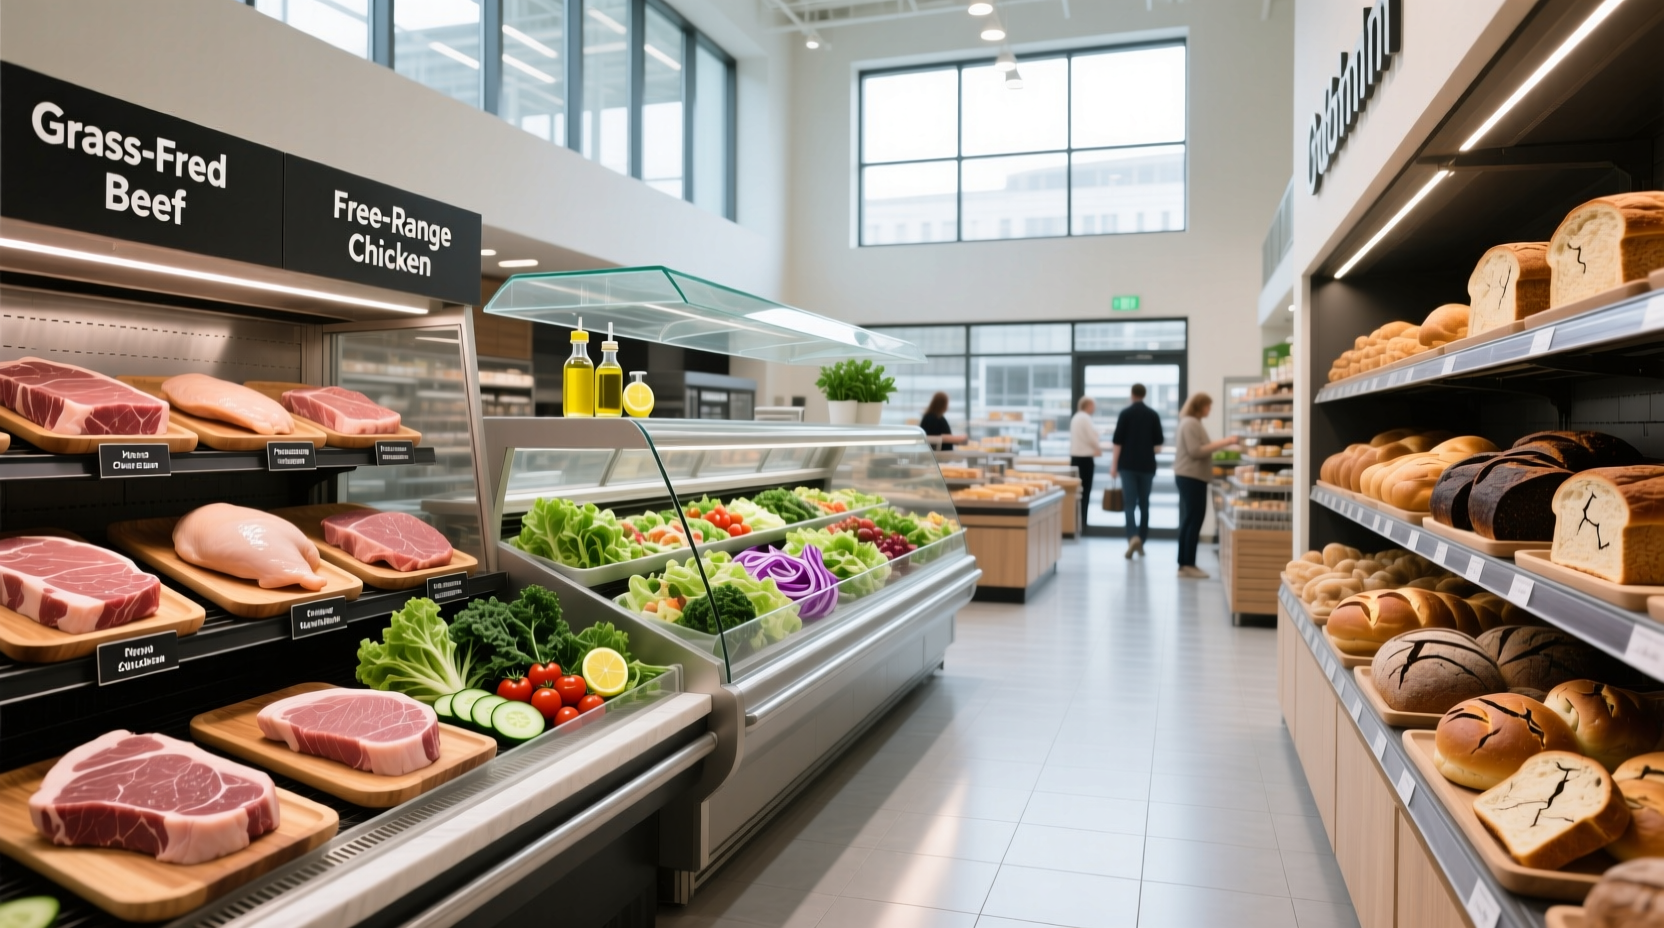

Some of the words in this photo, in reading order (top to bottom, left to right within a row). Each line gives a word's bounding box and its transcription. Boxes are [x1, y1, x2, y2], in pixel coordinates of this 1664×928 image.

[31, 101, 227, 188] Grass-Fred
[105, 172, 187, 225] Beef
[333, 189, 452, 251] Free-Range
[348, 233, 431, 276] Chicken
